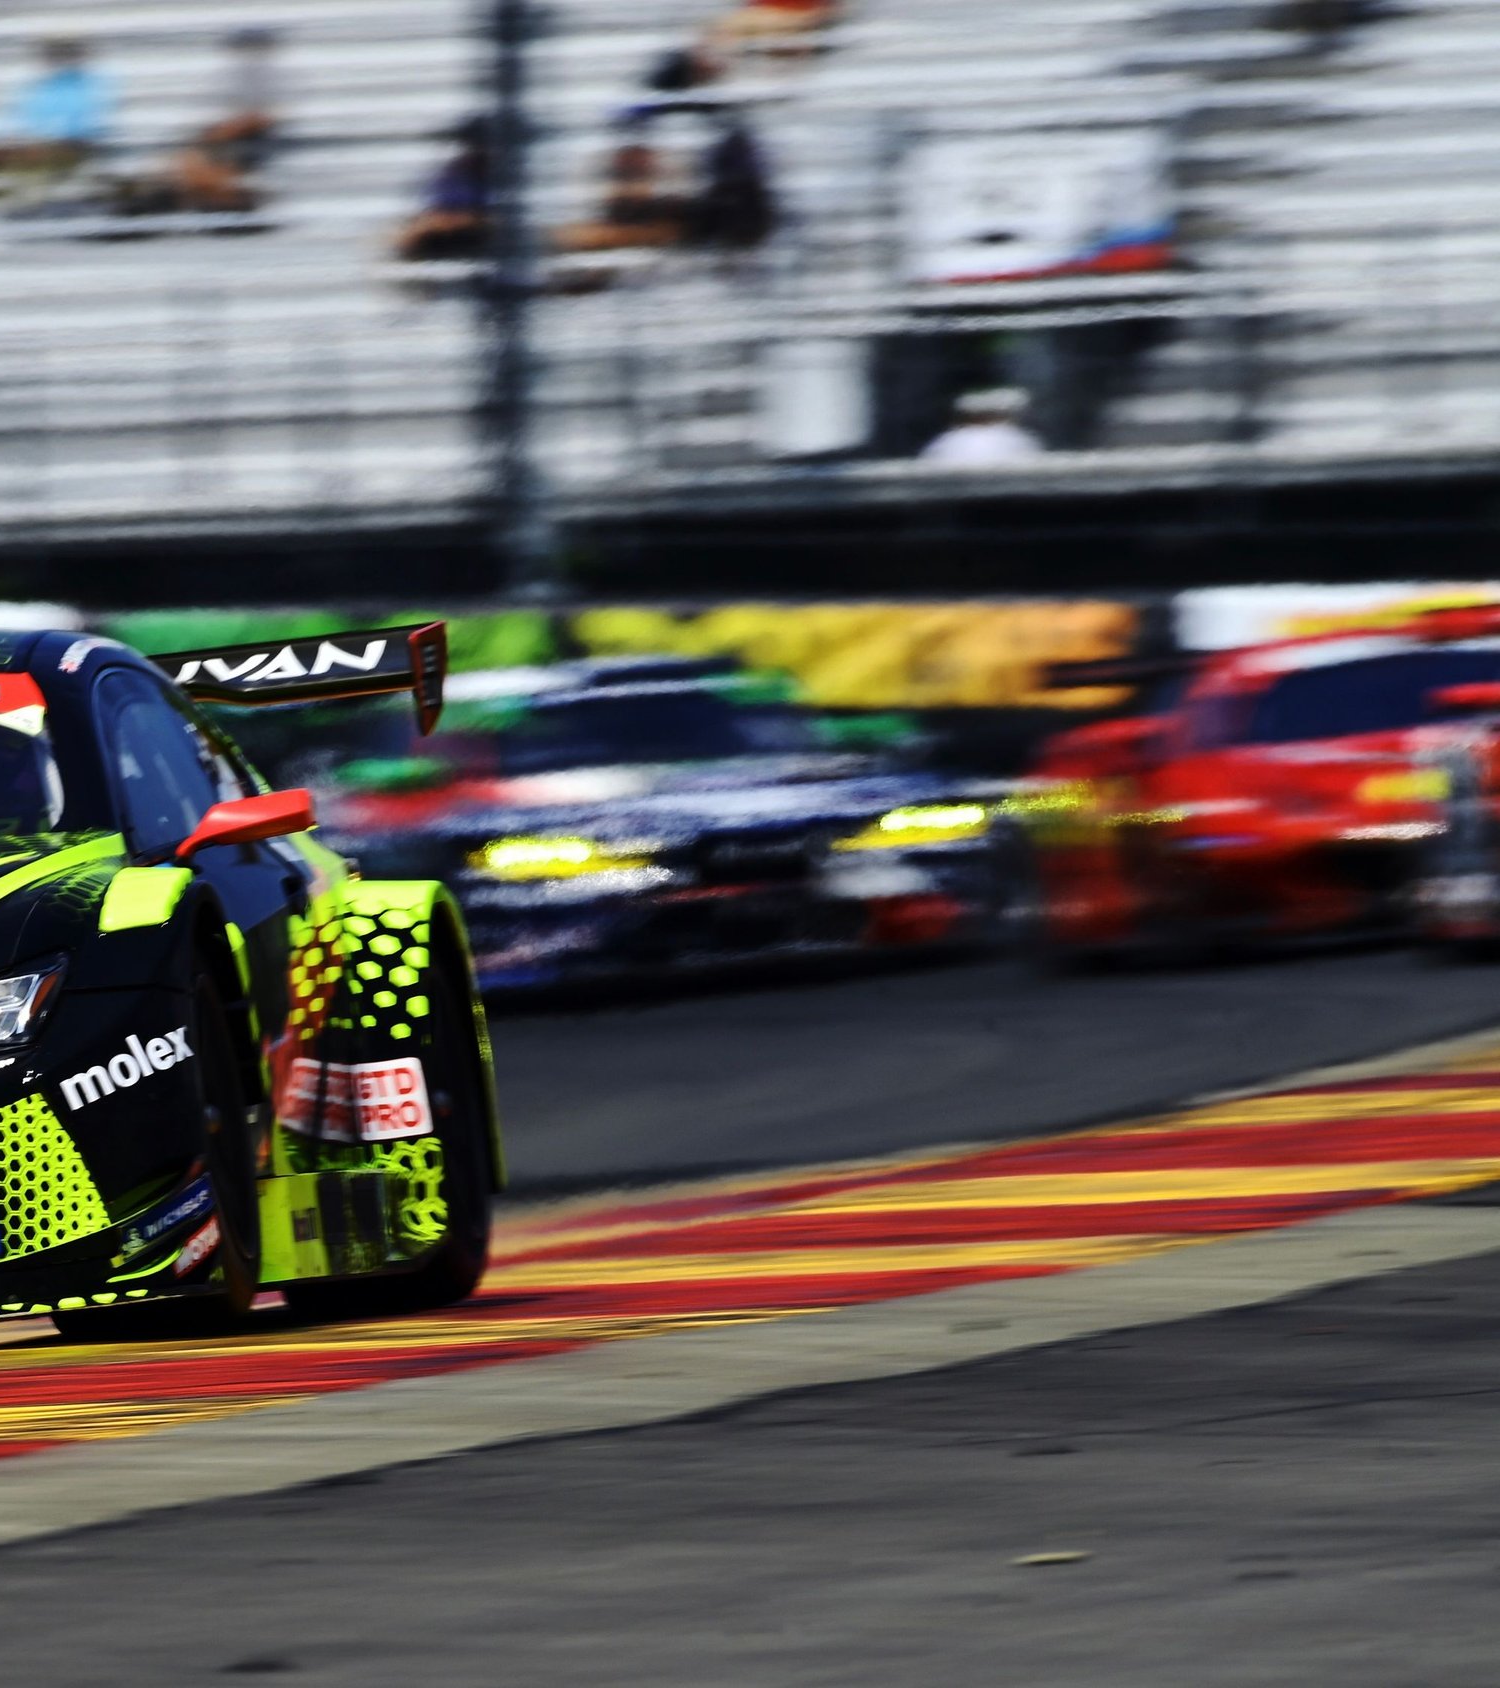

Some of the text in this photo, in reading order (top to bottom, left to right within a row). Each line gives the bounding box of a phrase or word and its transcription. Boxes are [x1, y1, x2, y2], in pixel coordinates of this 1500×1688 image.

[59, 1025, 195, 1112] molex
[356, 1067, 418, 1100] GTD
[358, 1100, 423, 1133] PRO
